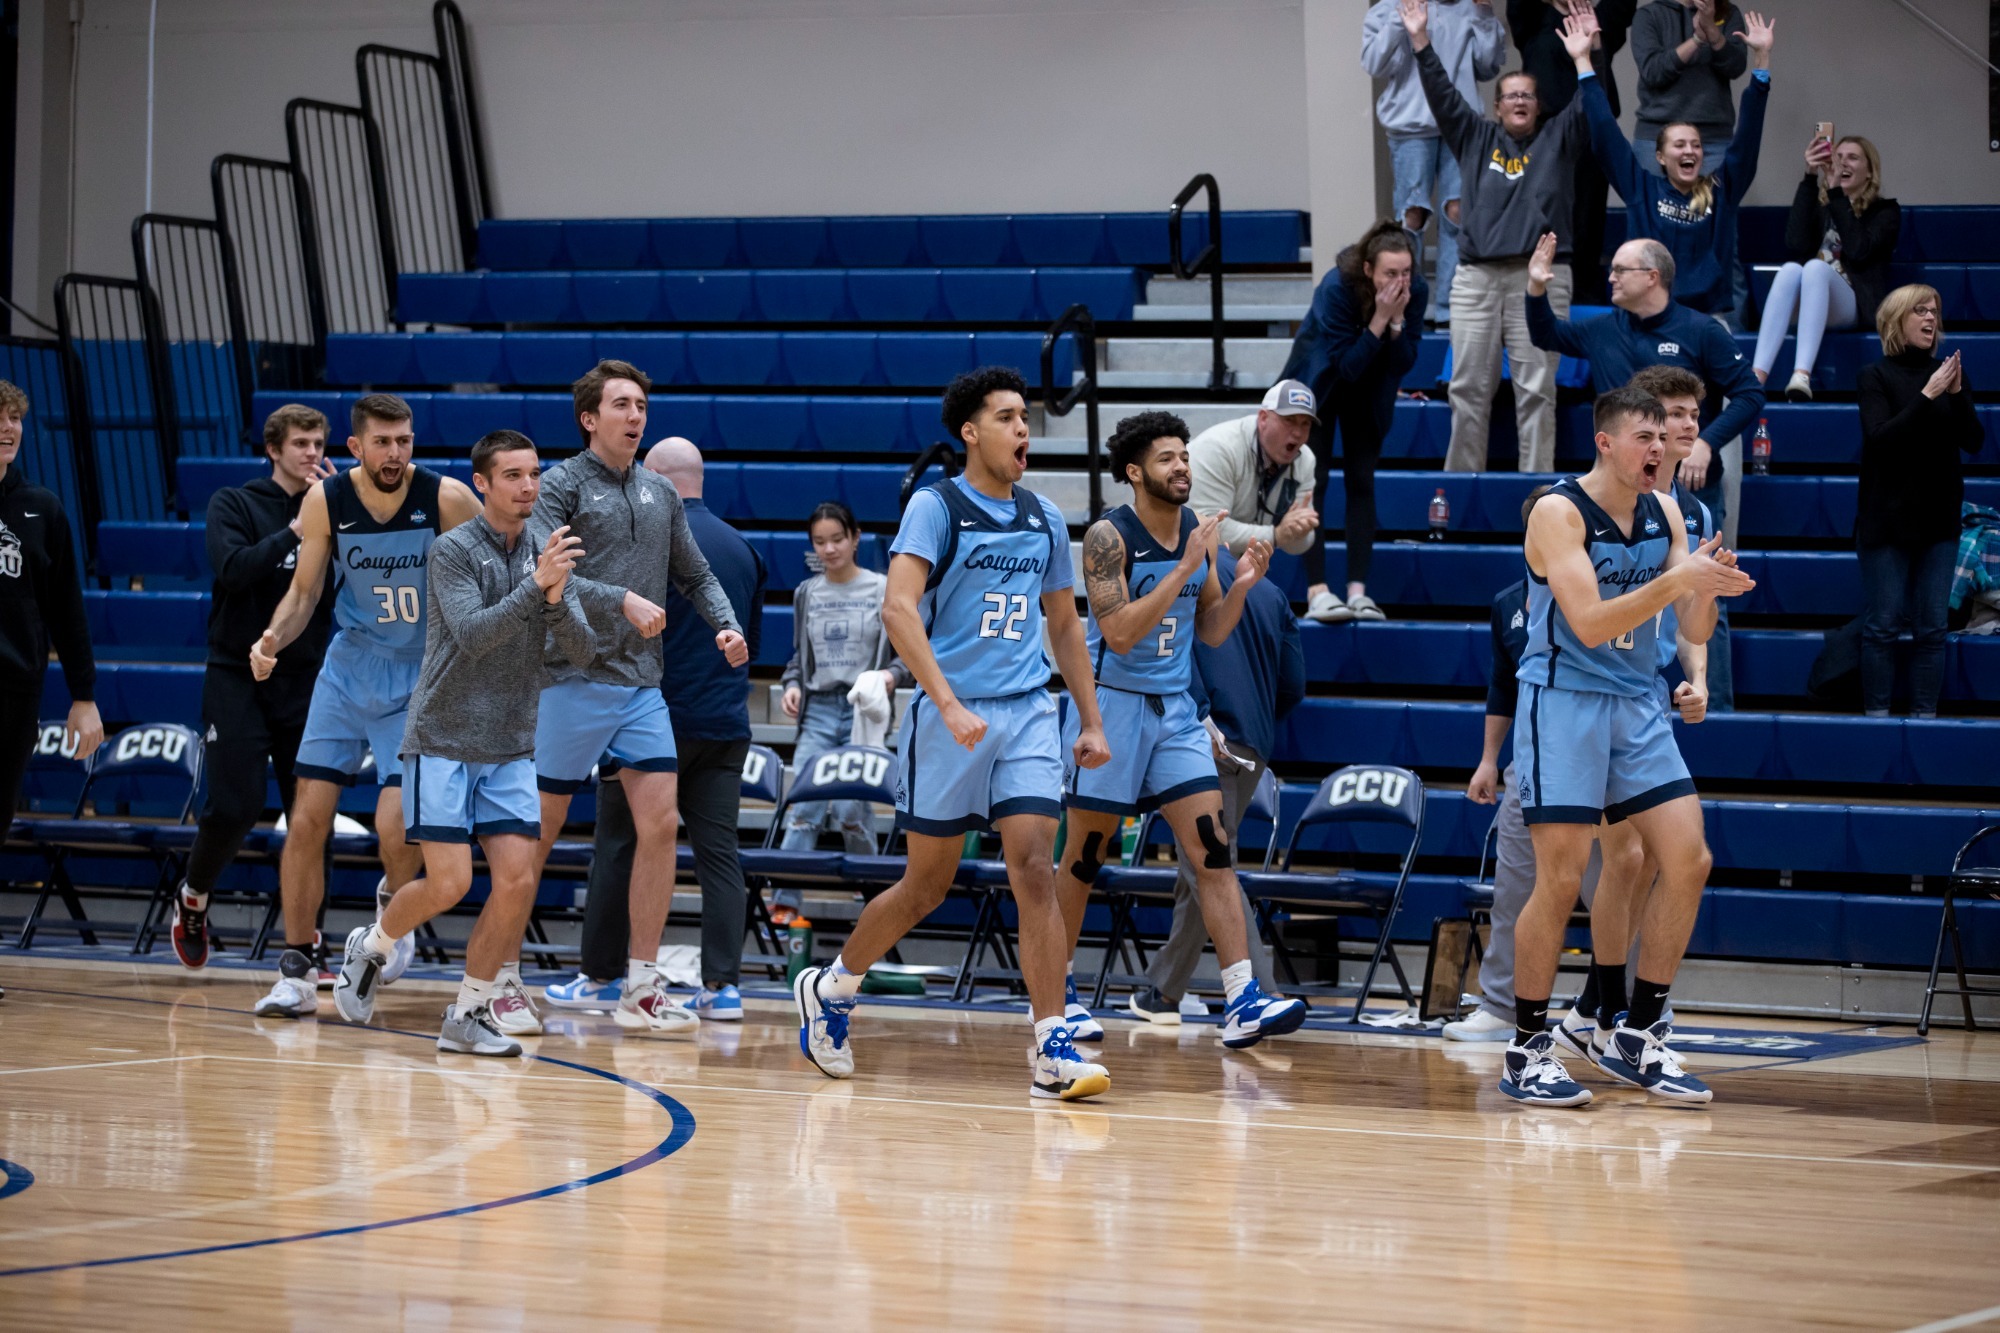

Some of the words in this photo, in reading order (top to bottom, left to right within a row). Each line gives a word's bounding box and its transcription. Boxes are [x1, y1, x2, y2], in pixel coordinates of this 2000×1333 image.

[1657, 342, 1680, 354] CCU
[346, 545, 428, 579] Cougars
[371, 586, 420, 624] 30
[979, 592, 1028, 642] 22
[1156, 616, 1178, 657] 2
[115, 728, 188, 763] CCU
[812, 751, 890, 787] CCU
[1328, 769, 1409, 807] CCU
